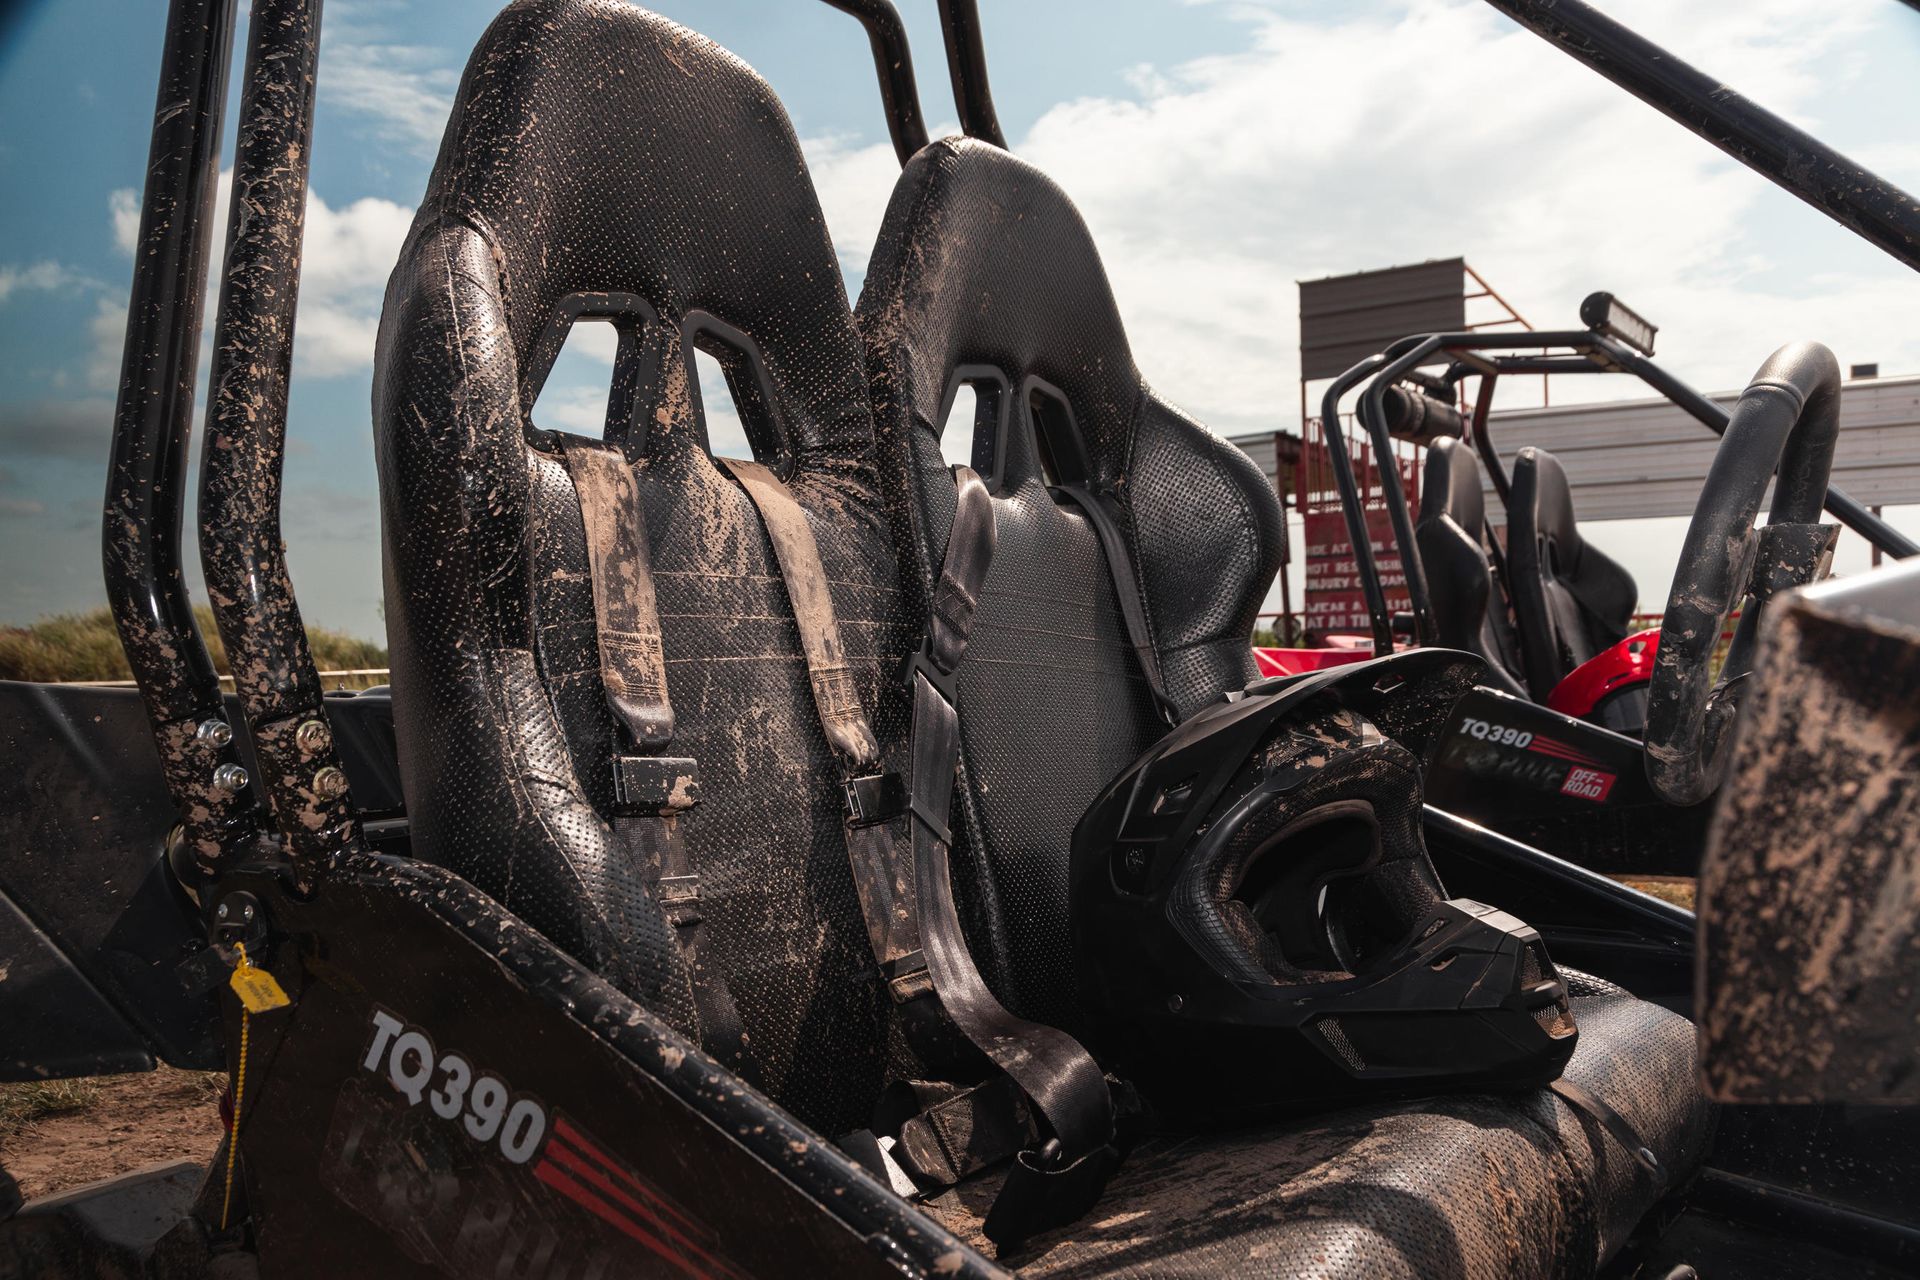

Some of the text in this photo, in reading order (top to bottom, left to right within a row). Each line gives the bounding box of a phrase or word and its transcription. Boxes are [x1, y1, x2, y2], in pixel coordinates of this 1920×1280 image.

[1459, 718, 1533, 748] TQ390
[1562, 780, 1602, 797] ROAD
[362, 1010, 546, 1164] TQ390
